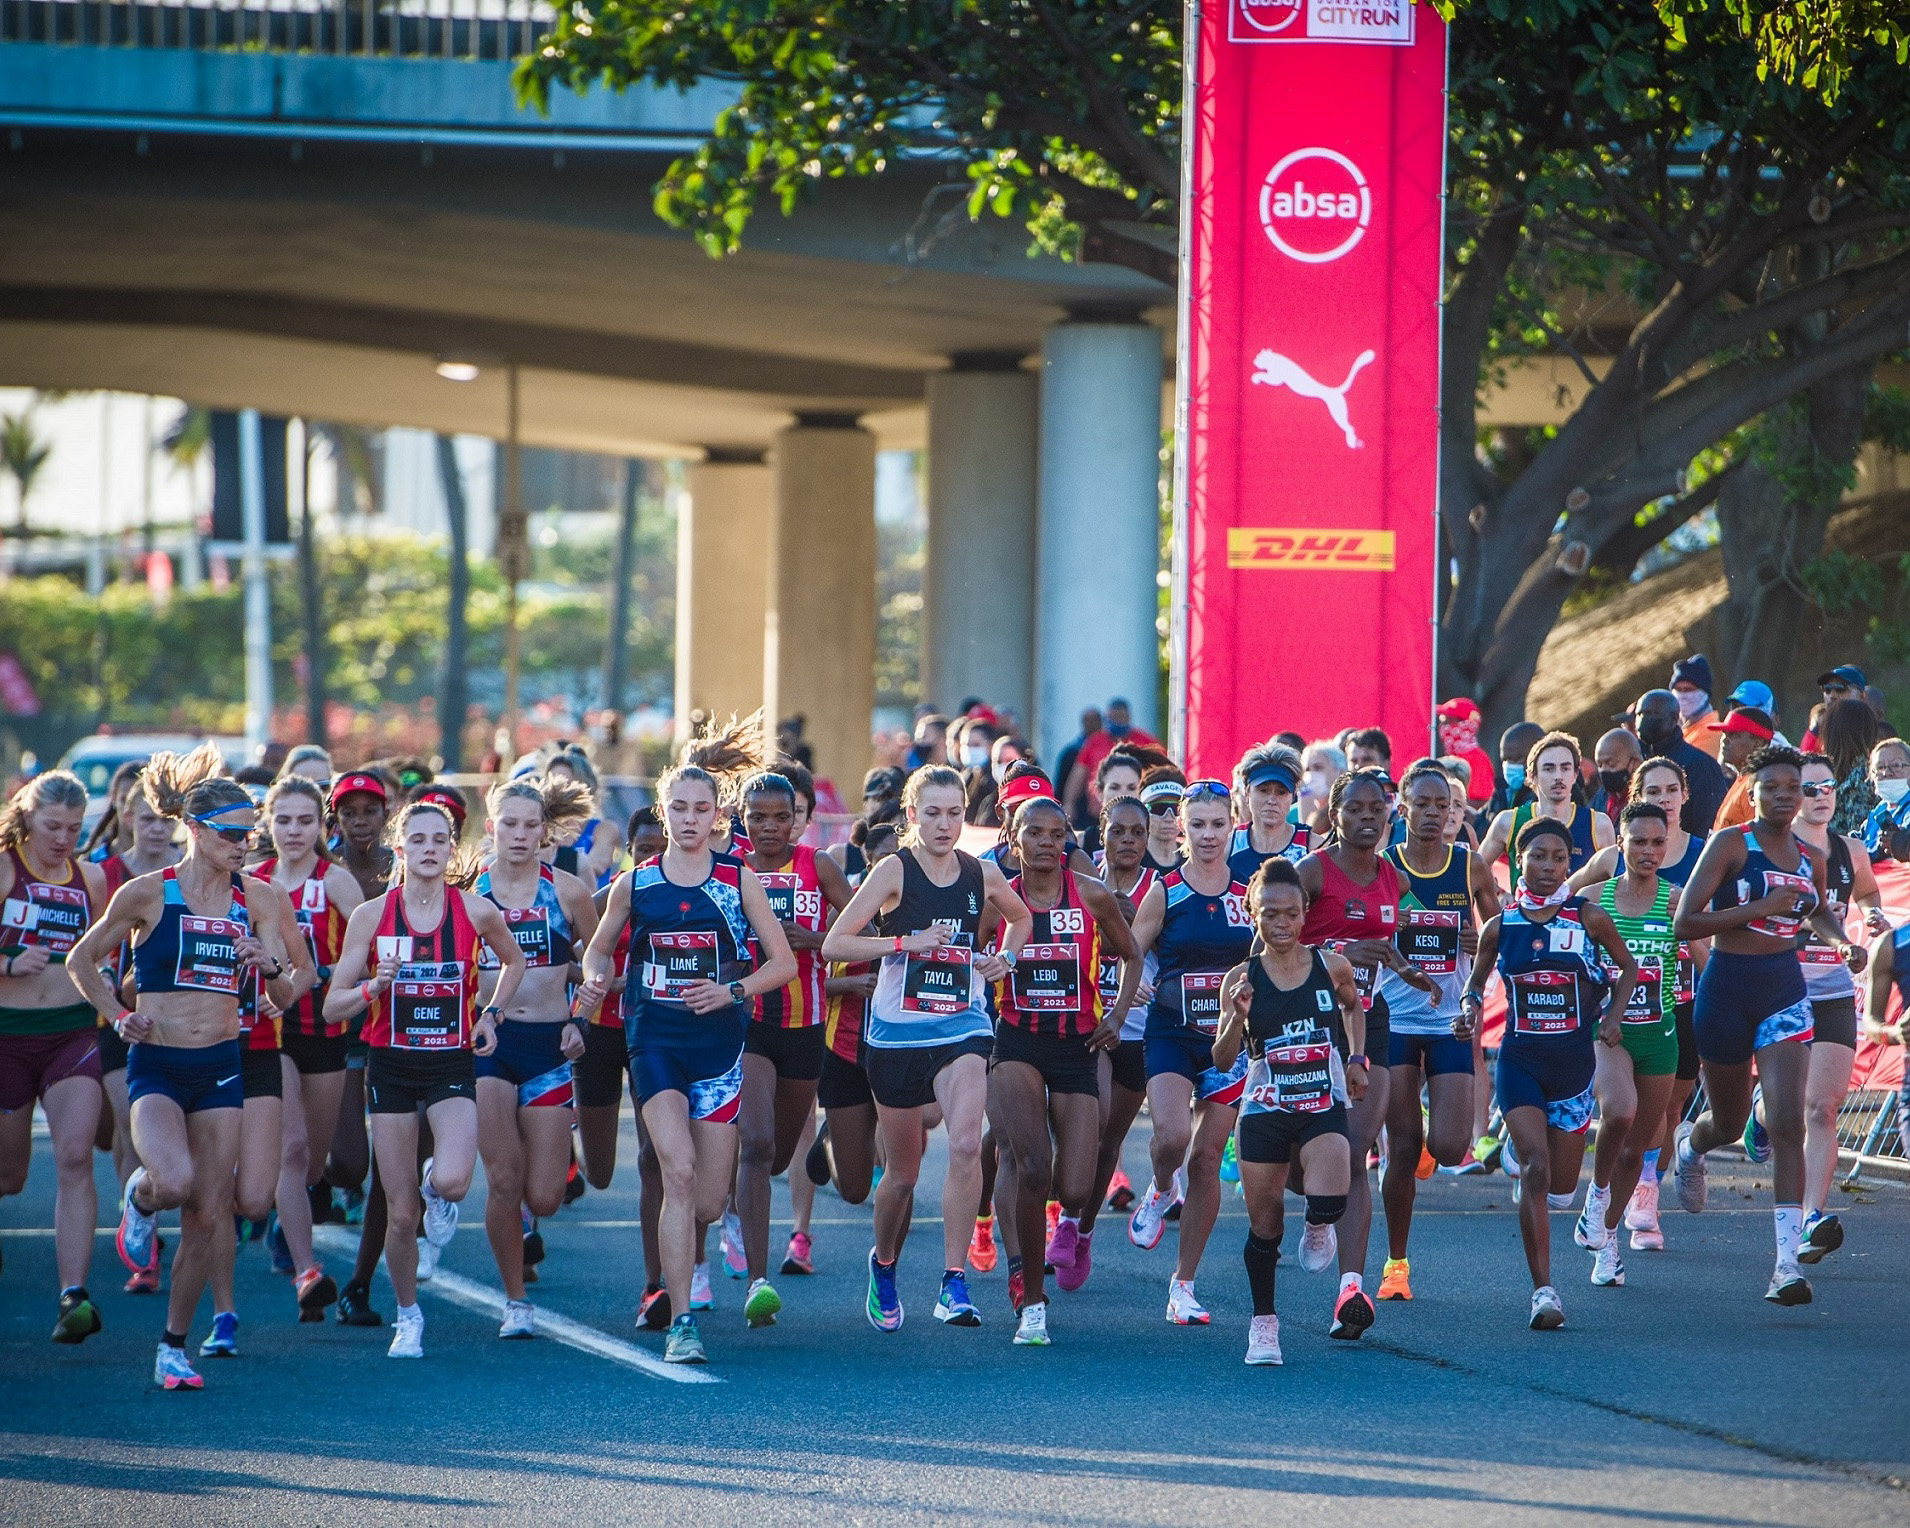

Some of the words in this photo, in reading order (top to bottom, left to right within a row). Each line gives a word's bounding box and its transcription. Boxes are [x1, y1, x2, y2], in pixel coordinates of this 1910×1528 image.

[1317, 7, 1399, 26] CITYRUN
[1272, 181, 1358, 218] absa
[1252, 537, 1370, 561] DHL
[306, 886, 318, 908] J
[796, 893, 818, 914] 35
[13, 905, 28, 924] J
[38, 908, 80, 926] MICHELLE
[1052, 911, 1081, 931] 35
[387, 938, 400, 957] J
[1560, 931, 1573, 950] J
[195, 942, 236, 959] IRVETTE
[670, 955, 698, 971] LIANÉ
[420, 968, 437, 977] 2021
[647, 966, 656, 986] J
[924, 970, 953, 986] TAYLA
[1033, 969, 1058, 981] LEBO
[934, 1003, 957, 1011] 2021
[1527, 993, 1565, 1006] KARABO
[414, 1007, 440, 1020] GENE
[1282, 1017, 1315, 1037] KZN
[1311, 1031, 1326, 1039] ASA
[1274, 1069, 1328, 1086] MAKHOSAZANA
[1299, 1101, 1320, 1110] 2021
